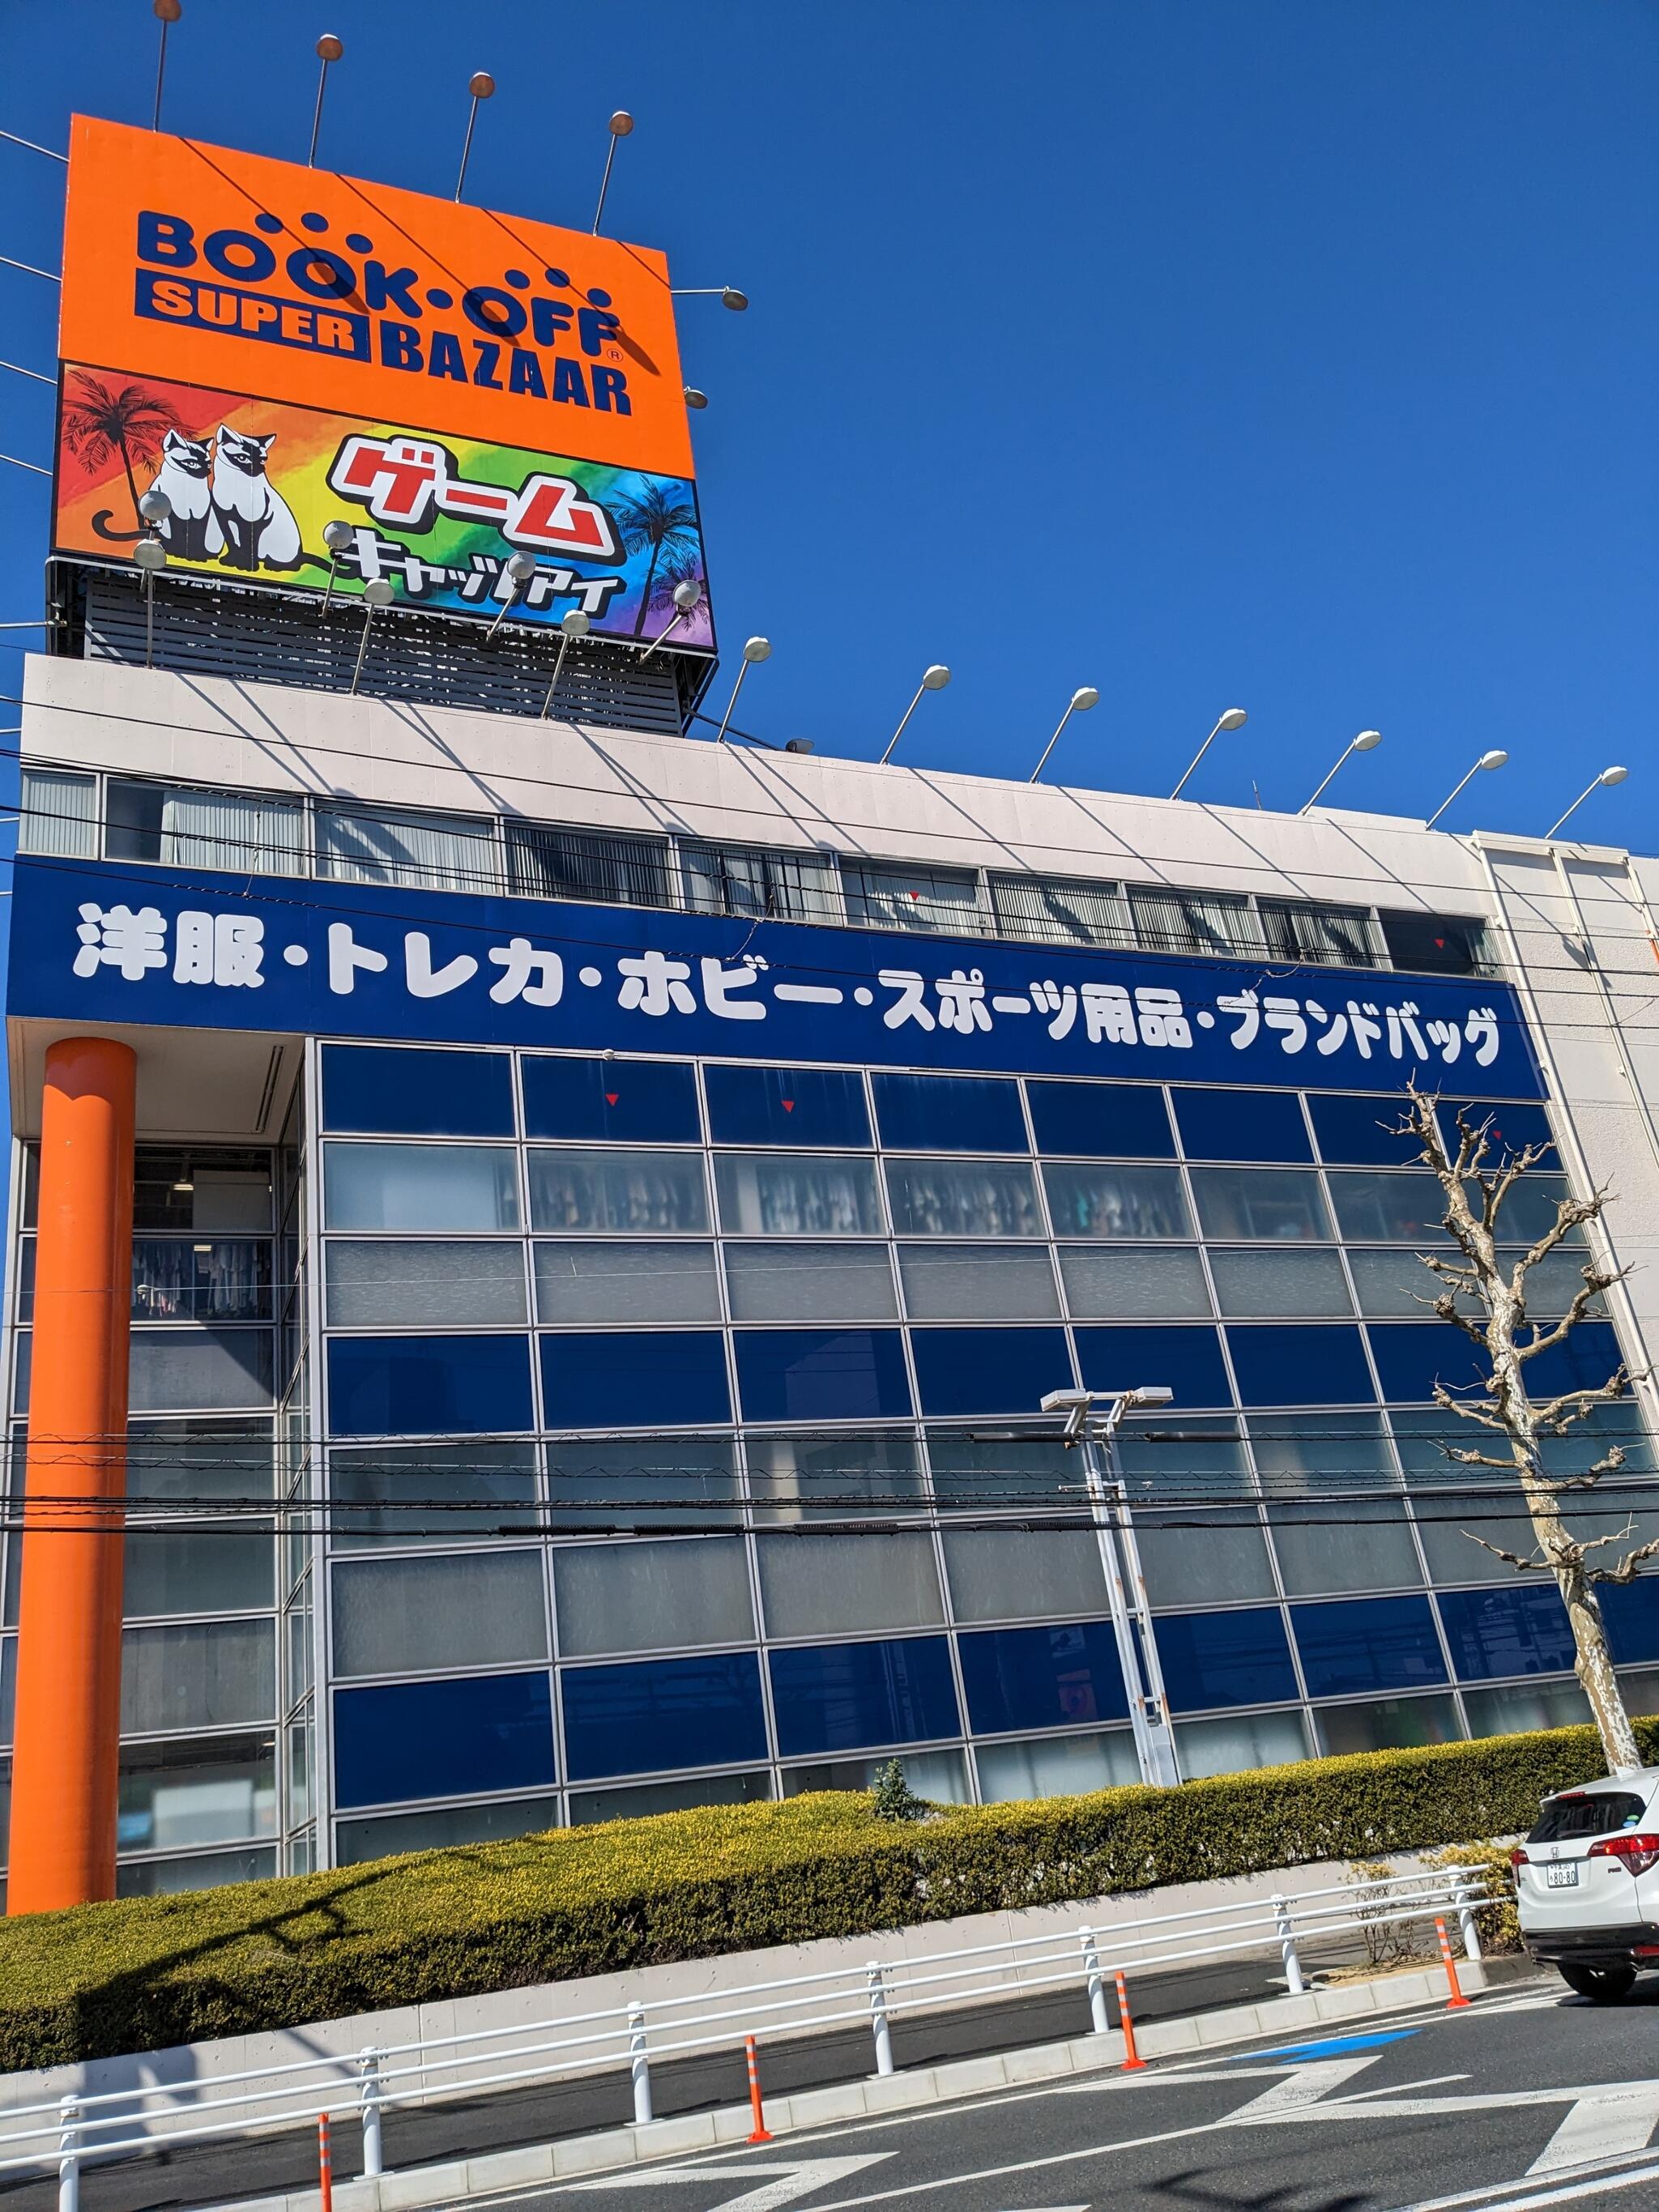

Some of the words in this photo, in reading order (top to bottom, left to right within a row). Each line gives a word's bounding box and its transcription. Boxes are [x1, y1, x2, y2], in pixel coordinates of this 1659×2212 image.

[151, 280, 355, 352] SUPER
[379, 319, 632, 416] BAZAAR
[331, 437, 615, 556] ゲーム
